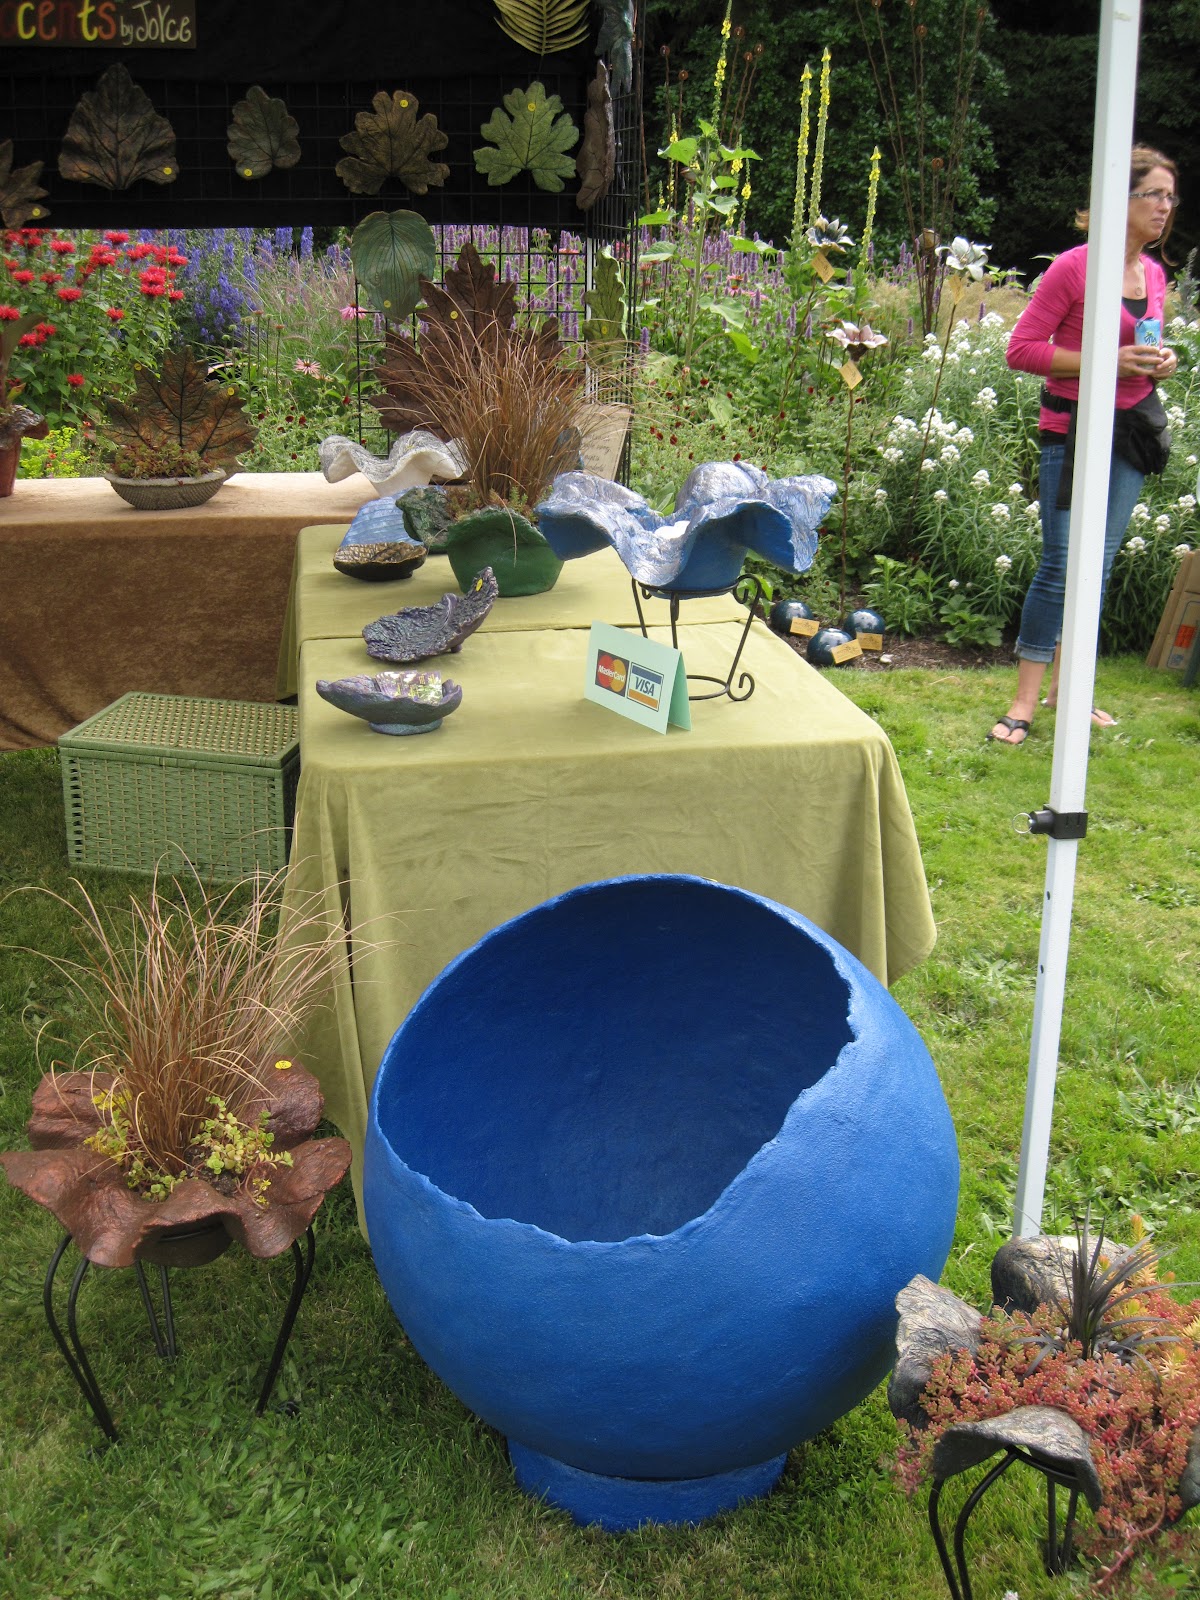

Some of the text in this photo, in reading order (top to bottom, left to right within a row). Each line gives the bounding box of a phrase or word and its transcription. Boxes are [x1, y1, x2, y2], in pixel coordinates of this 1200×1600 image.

[120, 15, 133, 46] by
[598, 664, 625, 682] MasterCard
[635, 677, 655, 696] VISA
